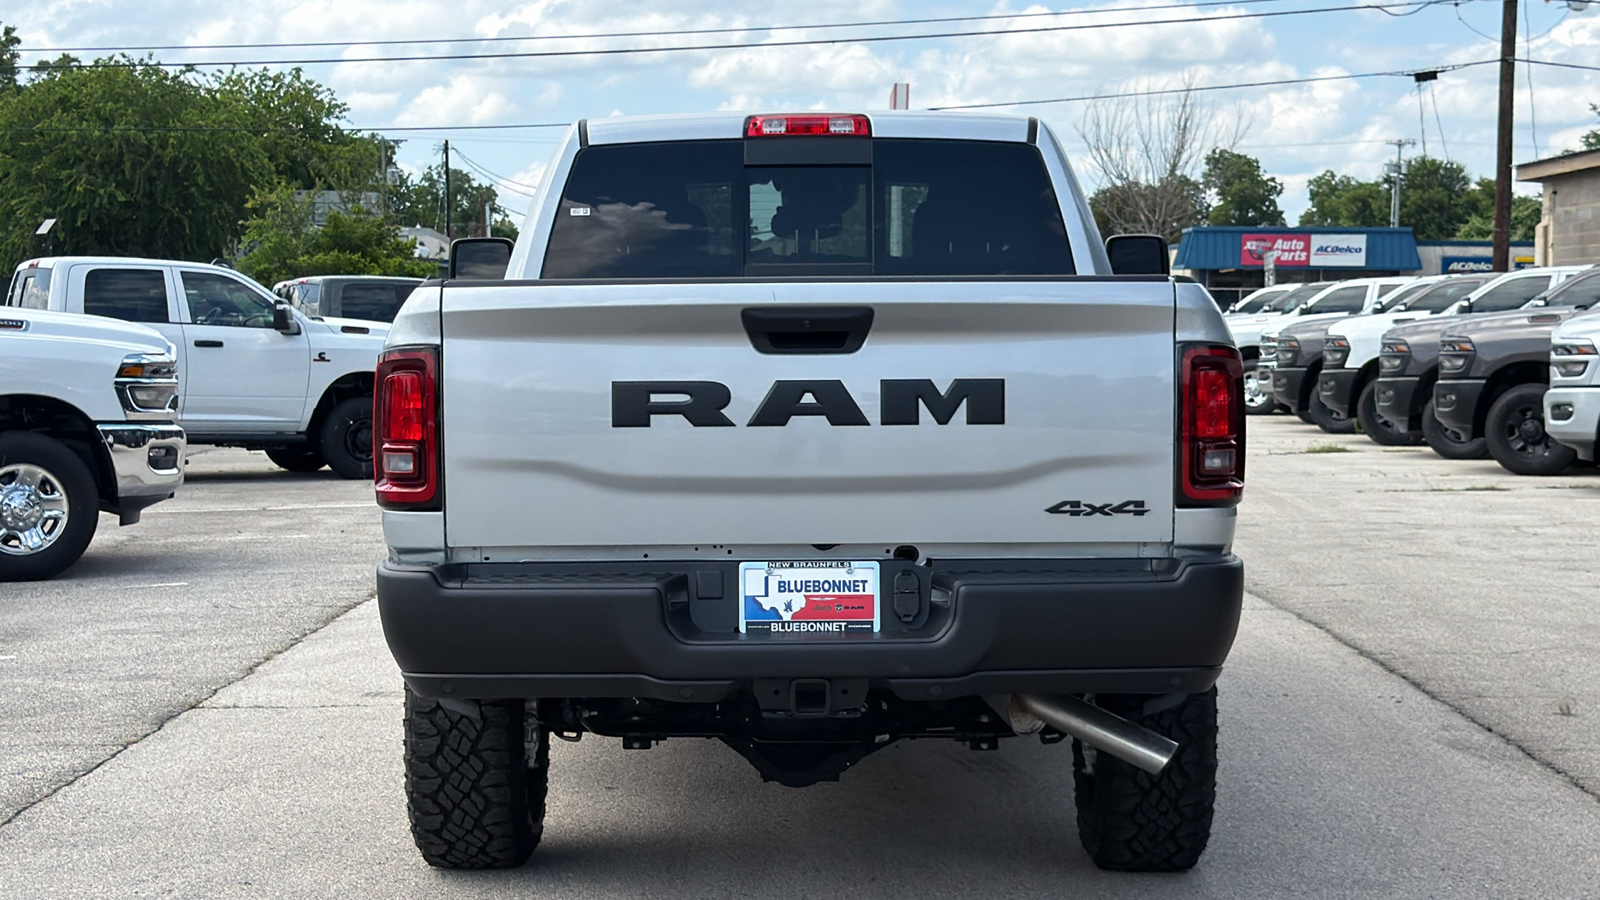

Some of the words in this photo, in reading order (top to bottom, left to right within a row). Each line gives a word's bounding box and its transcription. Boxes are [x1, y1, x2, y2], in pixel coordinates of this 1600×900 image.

[1273, 239, 1304, 251] Auto
[1315, 245, 1363, 254] ACDelco
[1273, 249, 1307, 261] Parts
[1448, 261, 1493, 271] ACDelc
[611, 378, 1006, 428] RAM
[1045, 499, 1151, 517] 4x4
[778, 580, 868, 593] BLUEBONNET
[770, 622, 847, 632] BLUEBONNET
